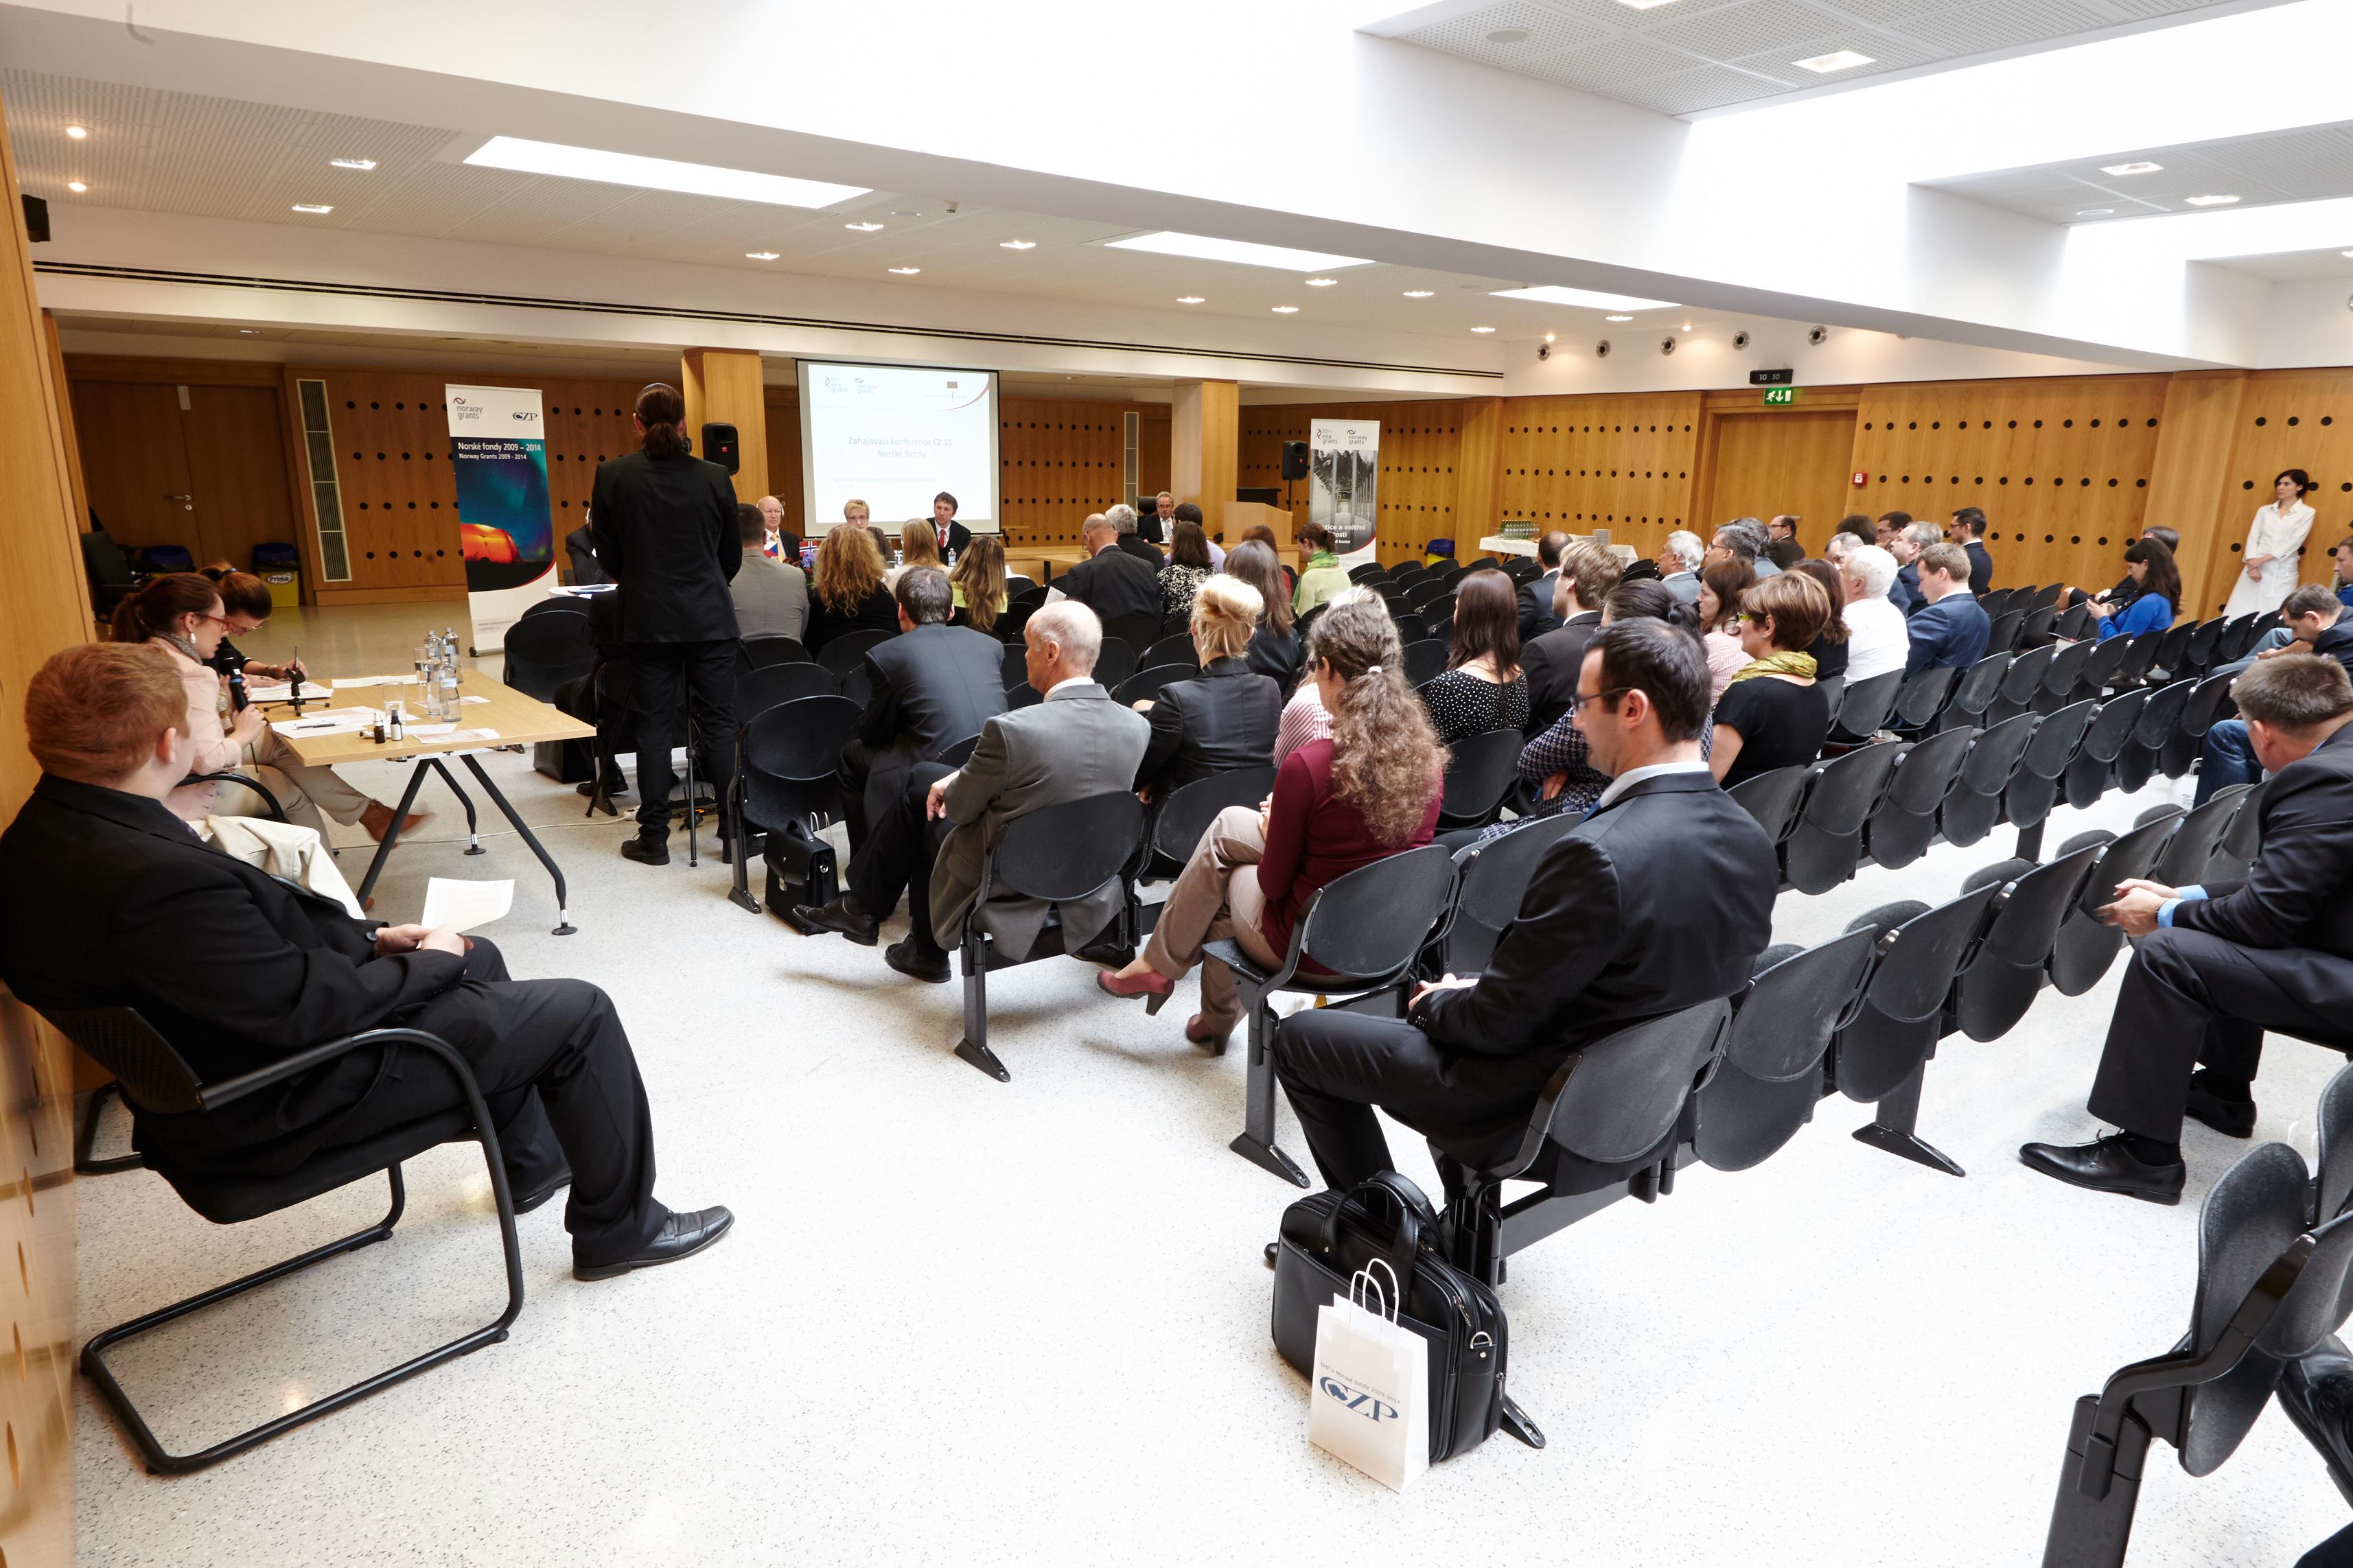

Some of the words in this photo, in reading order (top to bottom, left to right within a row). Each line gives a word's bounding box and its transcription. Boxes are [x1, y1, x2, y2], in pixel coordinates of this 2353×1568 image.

[456, 406, 483, 414] norway
[890, 437, 931, 445] konference
[458, 442, 481, 450] Norské
[483, 442, 502, 452] fondy
[905, 449, 926, 459] fondy
[1354, 1379, 1369, 1390] fondy
[1371, 1387, 1400, 1404] 2009-2014
